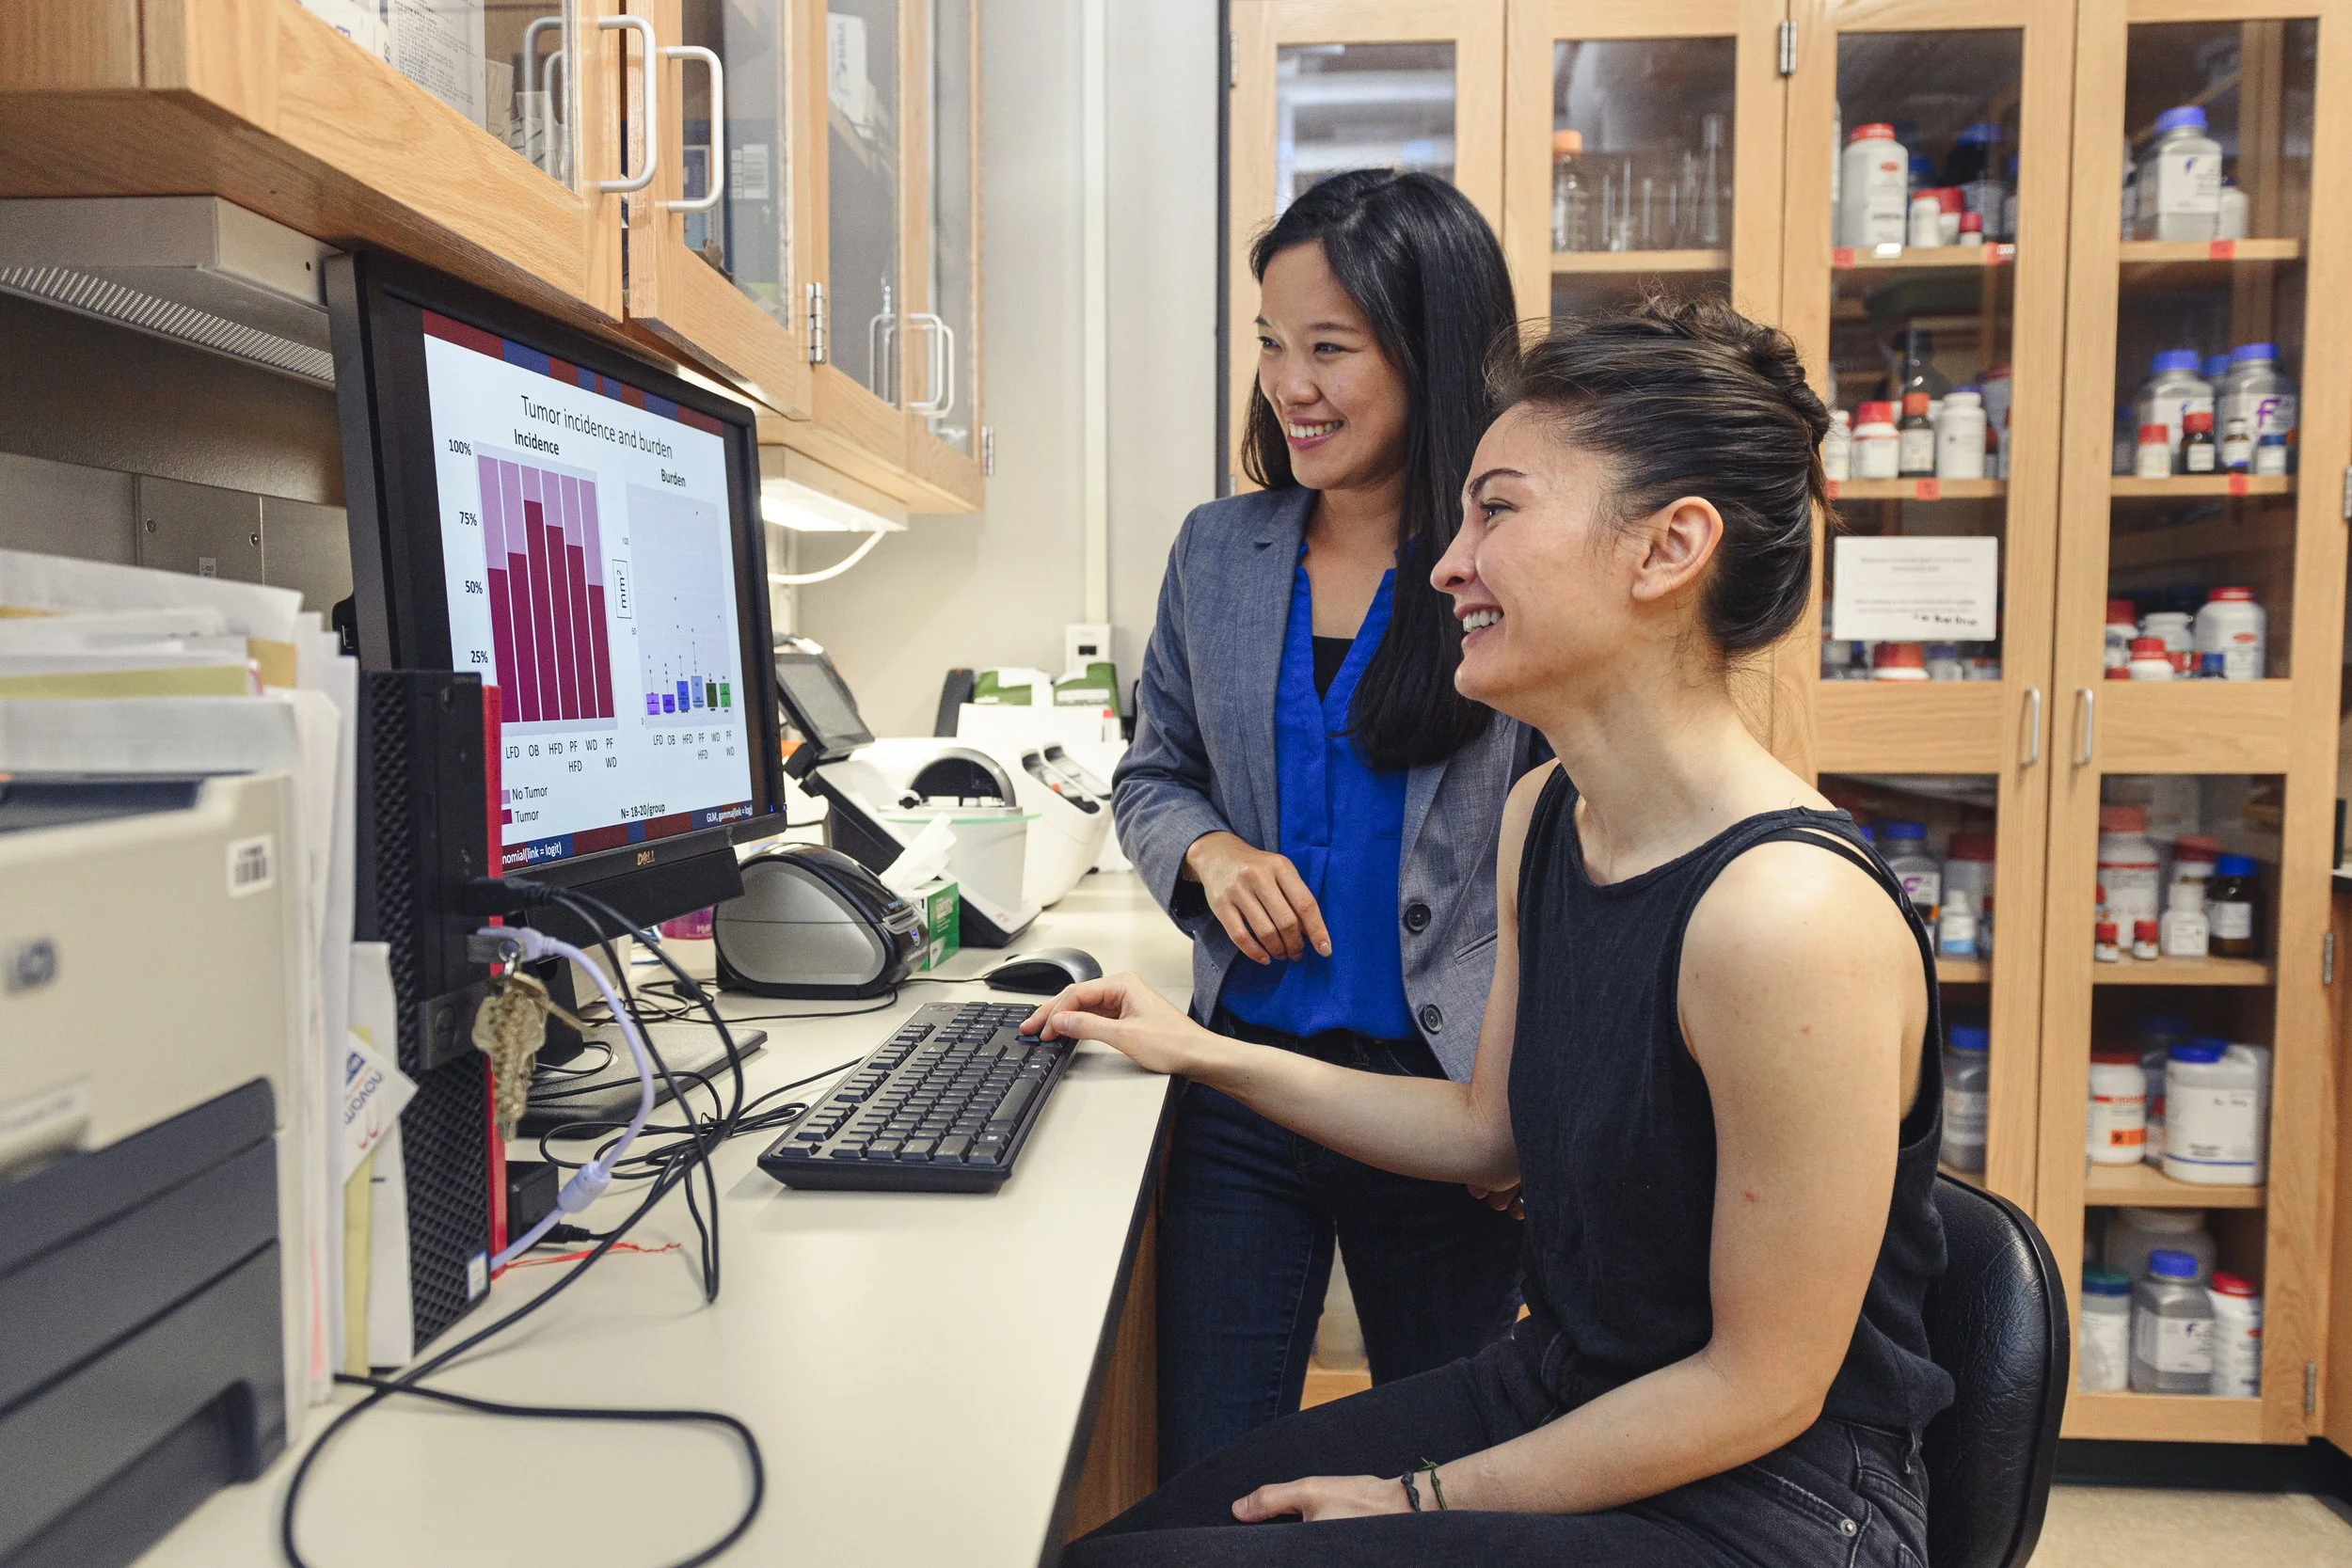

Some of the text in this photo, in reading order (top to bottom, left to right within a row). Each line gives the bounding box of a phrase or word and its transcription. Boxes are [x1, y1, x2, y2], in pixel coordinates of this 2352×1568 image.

[520, 394, 674, 460] Tumor incidence and burden
[448, 438, 472, 456] 100%
[514, 428, 560, 455] Incidence
[660, 467, 687, 488] Burden
[458, 511, 478, 527] 75%
[465, 579, 484, 594] 50%
[469, 650, 489, 664] 25%
[653, 730, 732, 746] LFD OB HFD PF WD PF
[505, 737, 613, 759] LFD OB HFD PF WD PF
[697, 746, 735, 760] HFD WD
[568, 756, 617, 773] HFD WD
[512, 786, 548, 800] No Tumor
[515, 810, 539, 823] Tumor
[630, 801, 666, 817] 18-20/group
[545, 841, 563, 858] logit)
[637, 849, 656, 867] DELL
